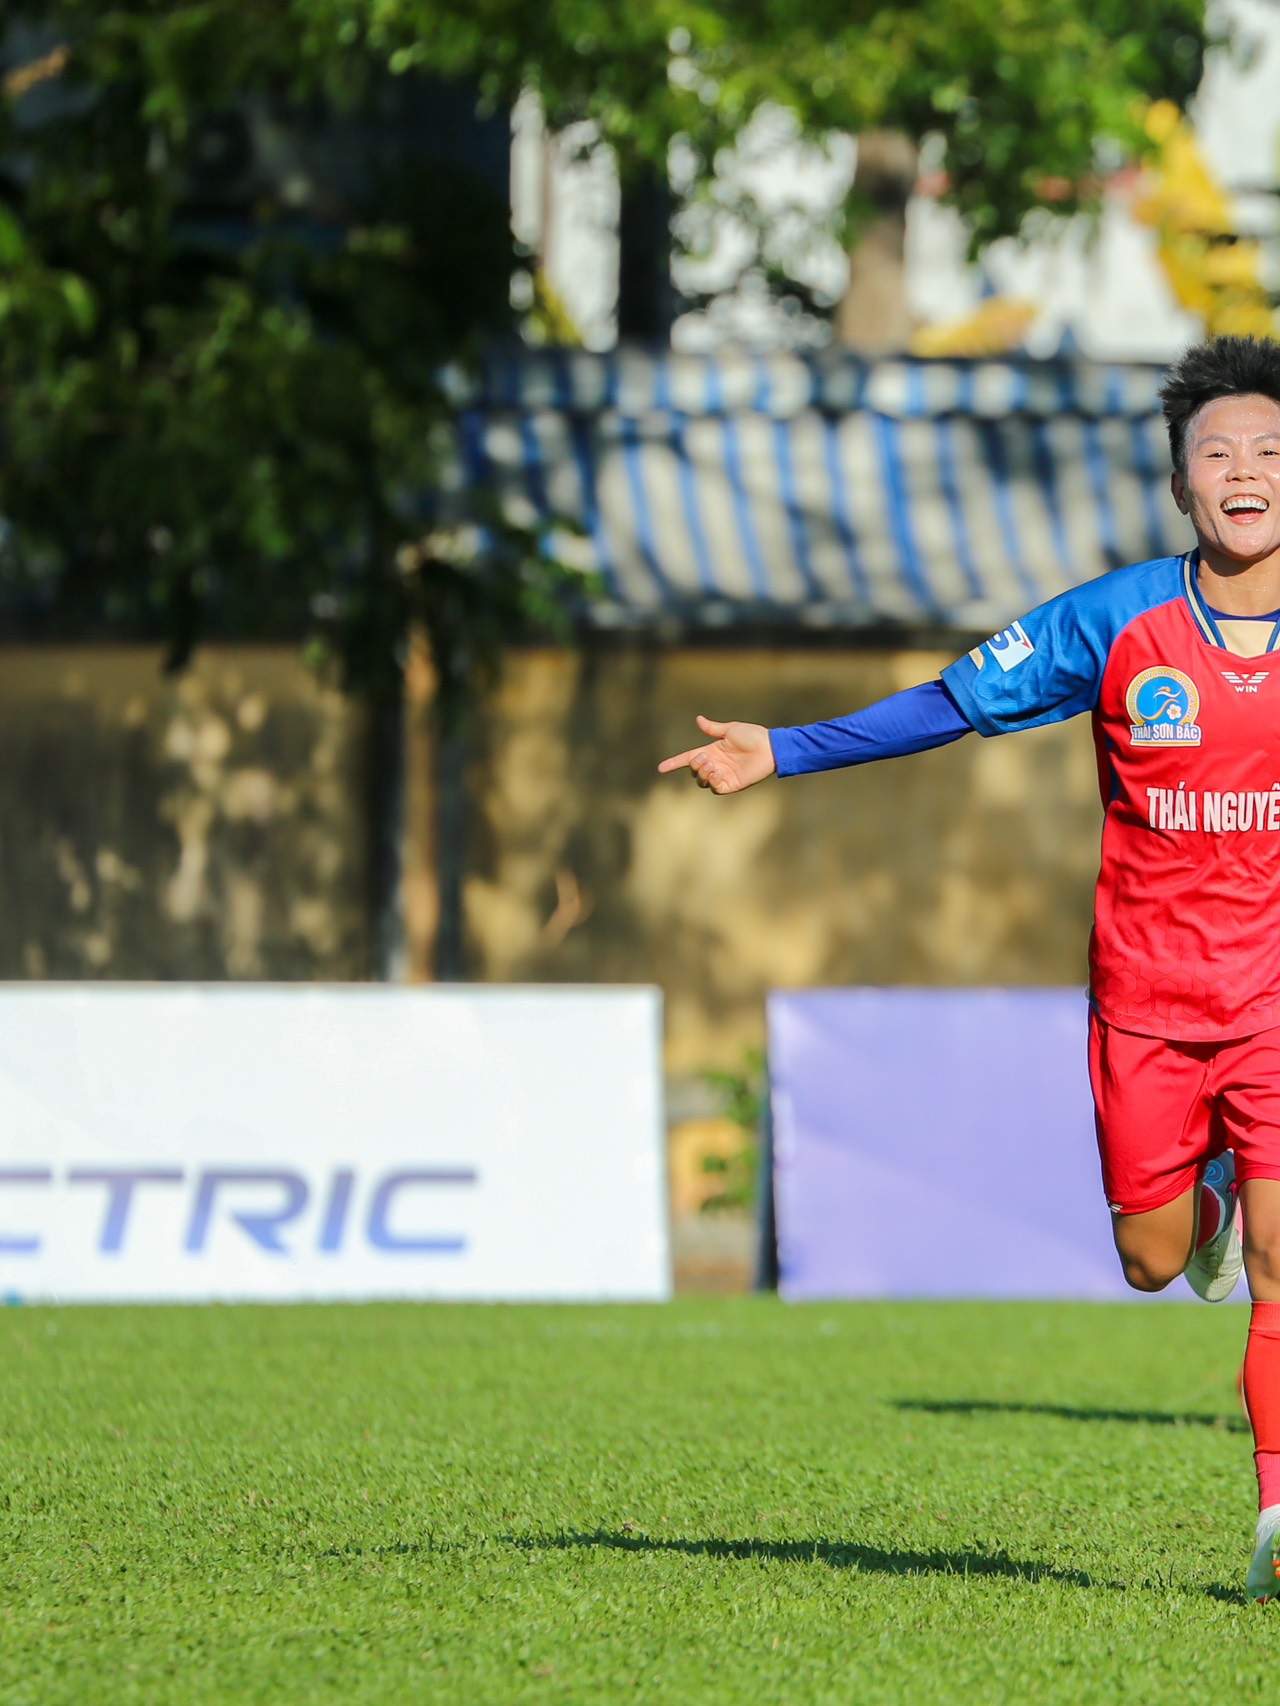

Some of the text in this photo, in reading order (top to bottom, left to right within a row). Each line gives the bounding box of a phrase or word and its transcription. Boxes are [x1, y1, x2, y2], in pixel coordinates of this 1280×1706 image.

[1234, 685, 1258, 693] WIN
[1134, 722, 1198, 740] THÁI SƠN BẮC
[1146, 781, 1197, 831] THÁI
